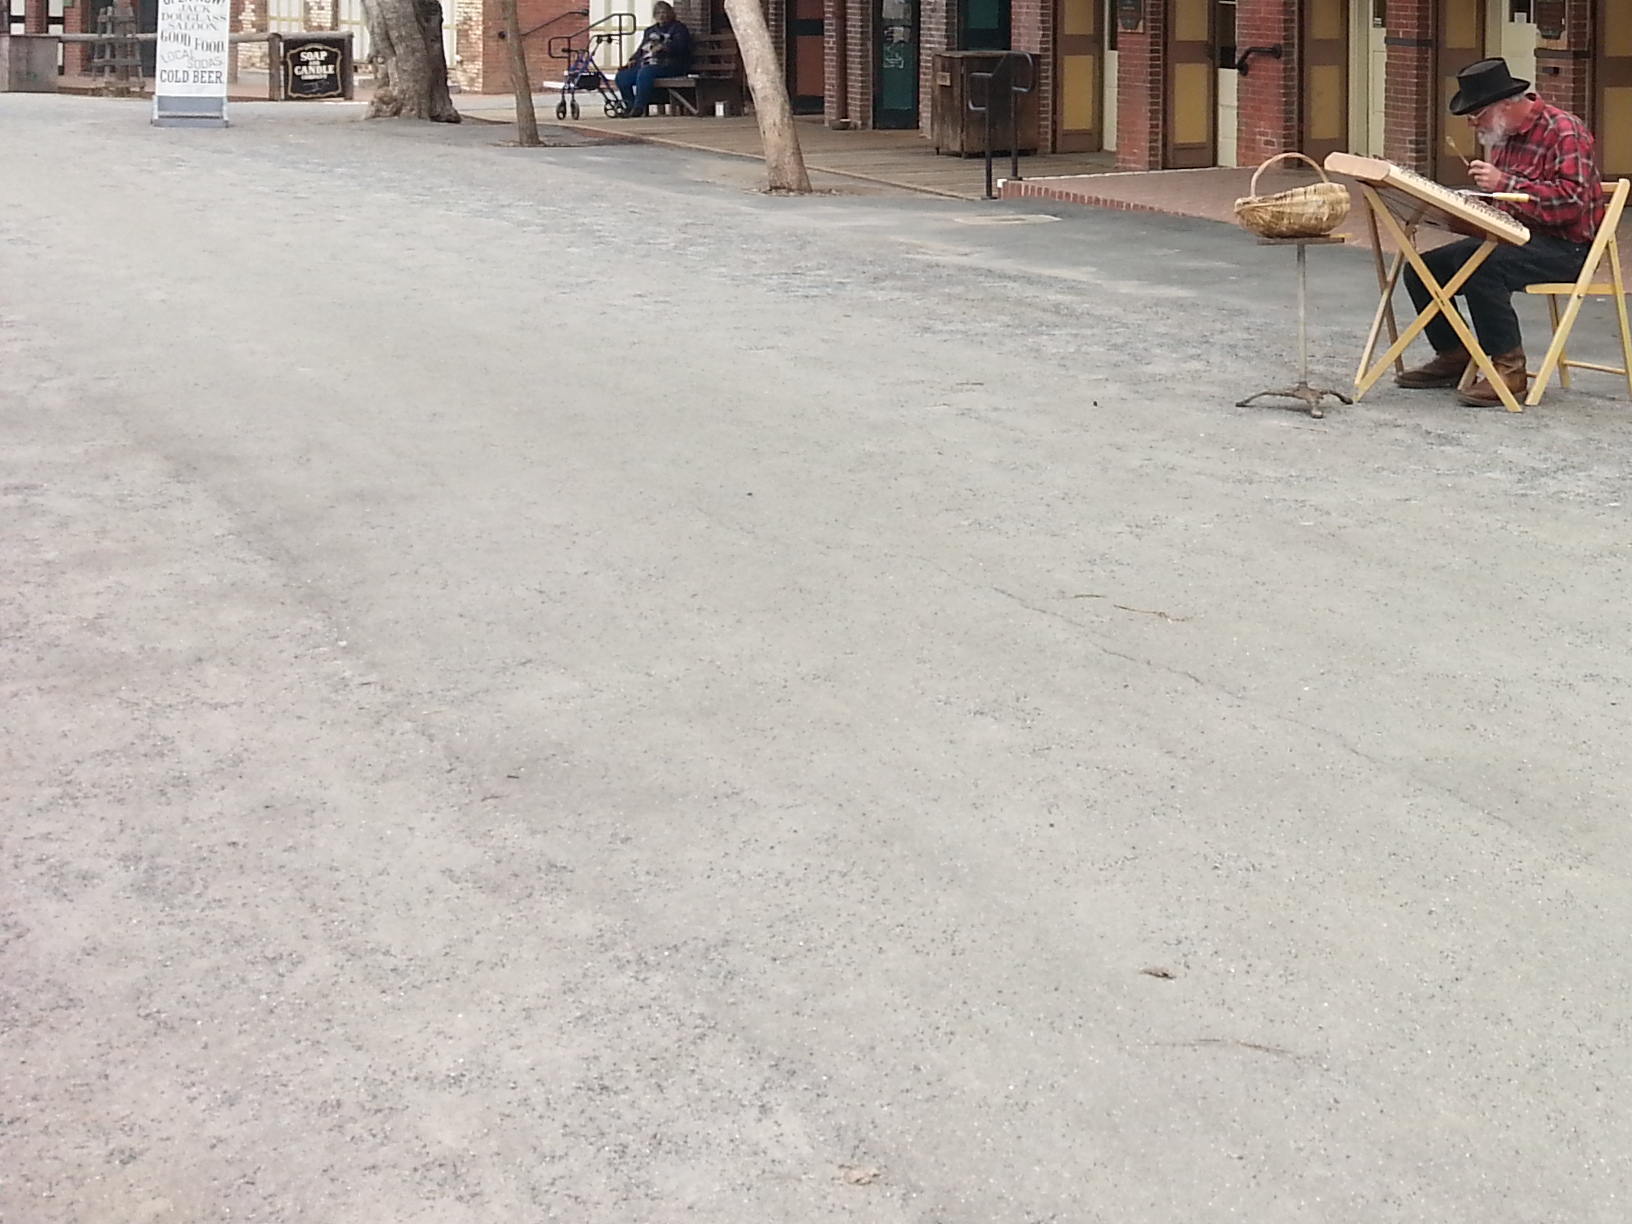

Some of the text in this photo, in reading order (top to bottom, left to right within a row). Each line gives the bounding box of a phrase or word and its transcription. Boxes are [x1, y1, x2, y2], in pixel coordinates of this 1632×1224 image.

[178, 4, 211, 14] JACK
[161, 12, 227, 22] DOUGLASS
[168, 22, 218, 31] SALOON
[160, 30, 225, 53] GOOD FOOD
[161, 49, 194, 64] LOCAL
[300, 50, 328, 62] SOAP
[187, 56, 223, 70] SODAS
[294, 64, 335, 76] CANDLE
[160, 70, 225, 84] COLD BEER
